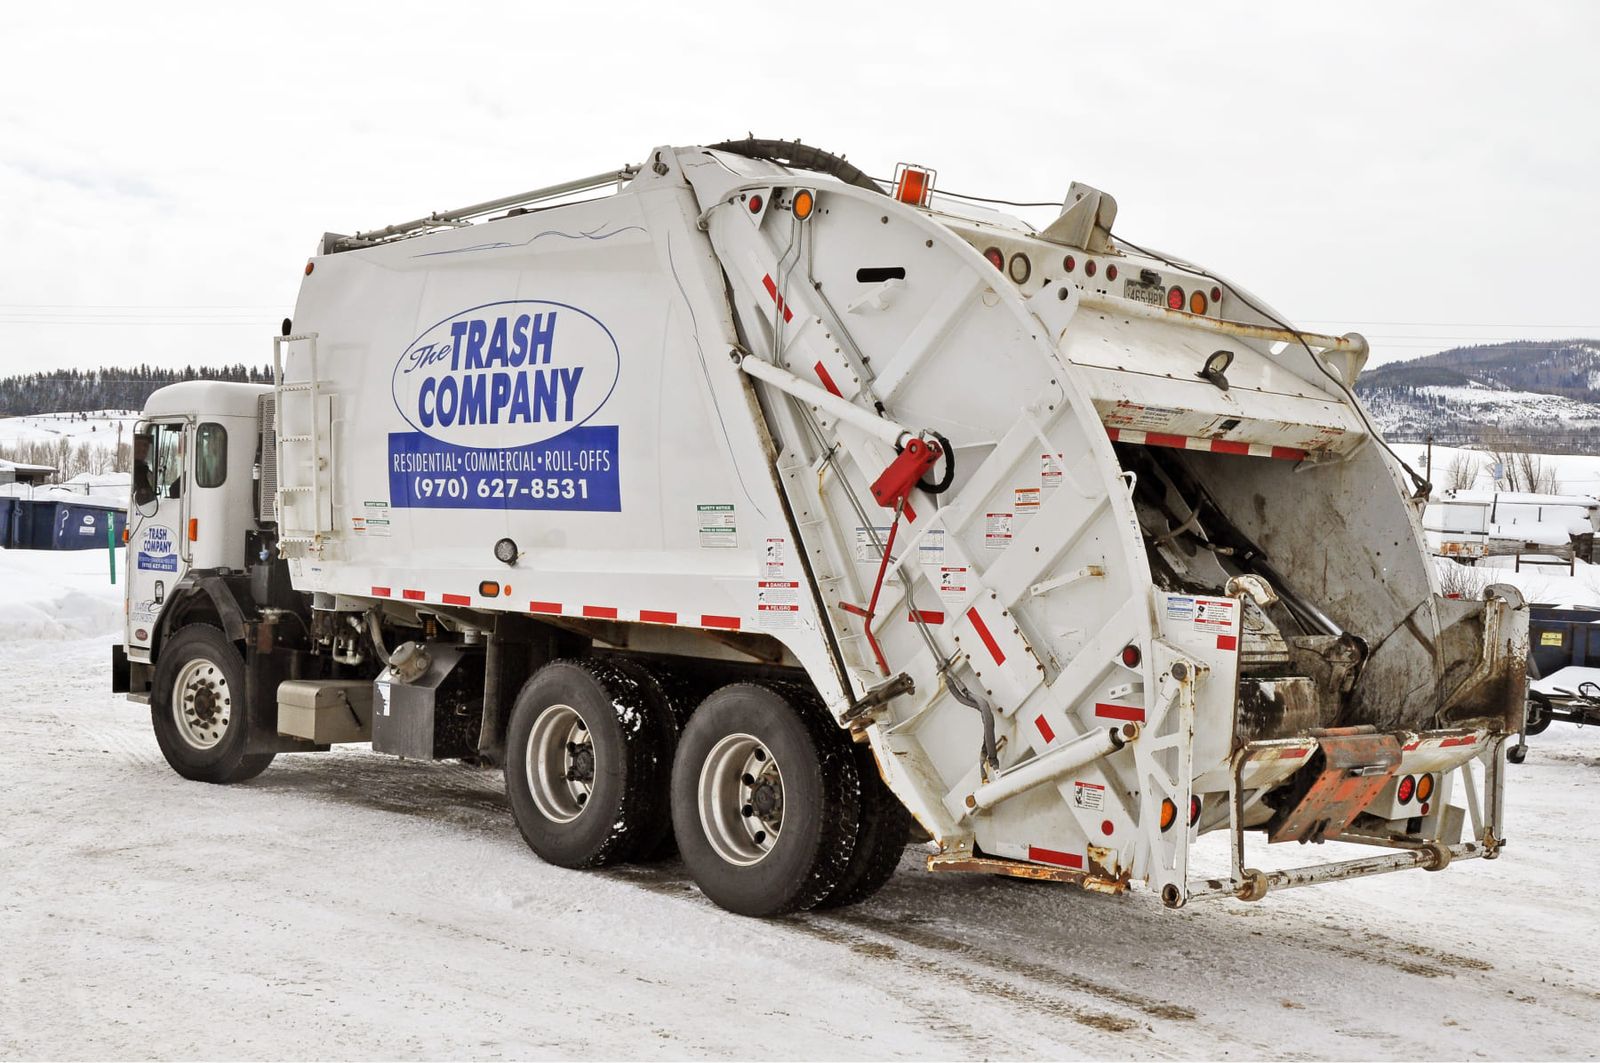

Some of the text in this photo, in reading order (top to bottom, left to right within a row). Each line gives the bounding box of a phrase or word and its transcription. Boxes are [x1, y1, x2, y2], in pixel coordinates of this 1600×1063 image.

[451, 312, 557, 371] TRASH
[404, 342, 451, 373] The
[418, 367, 584, 428] COMPANY
[394, 450, 610, 472] RESIDENTIAL COMMERCIAL ROLL-OFFS
[415, 476, 588, 499] (970) 627-8531
[149, 528, 167, 540] TRASH
[144, 540, 172, 553] COMPANY
